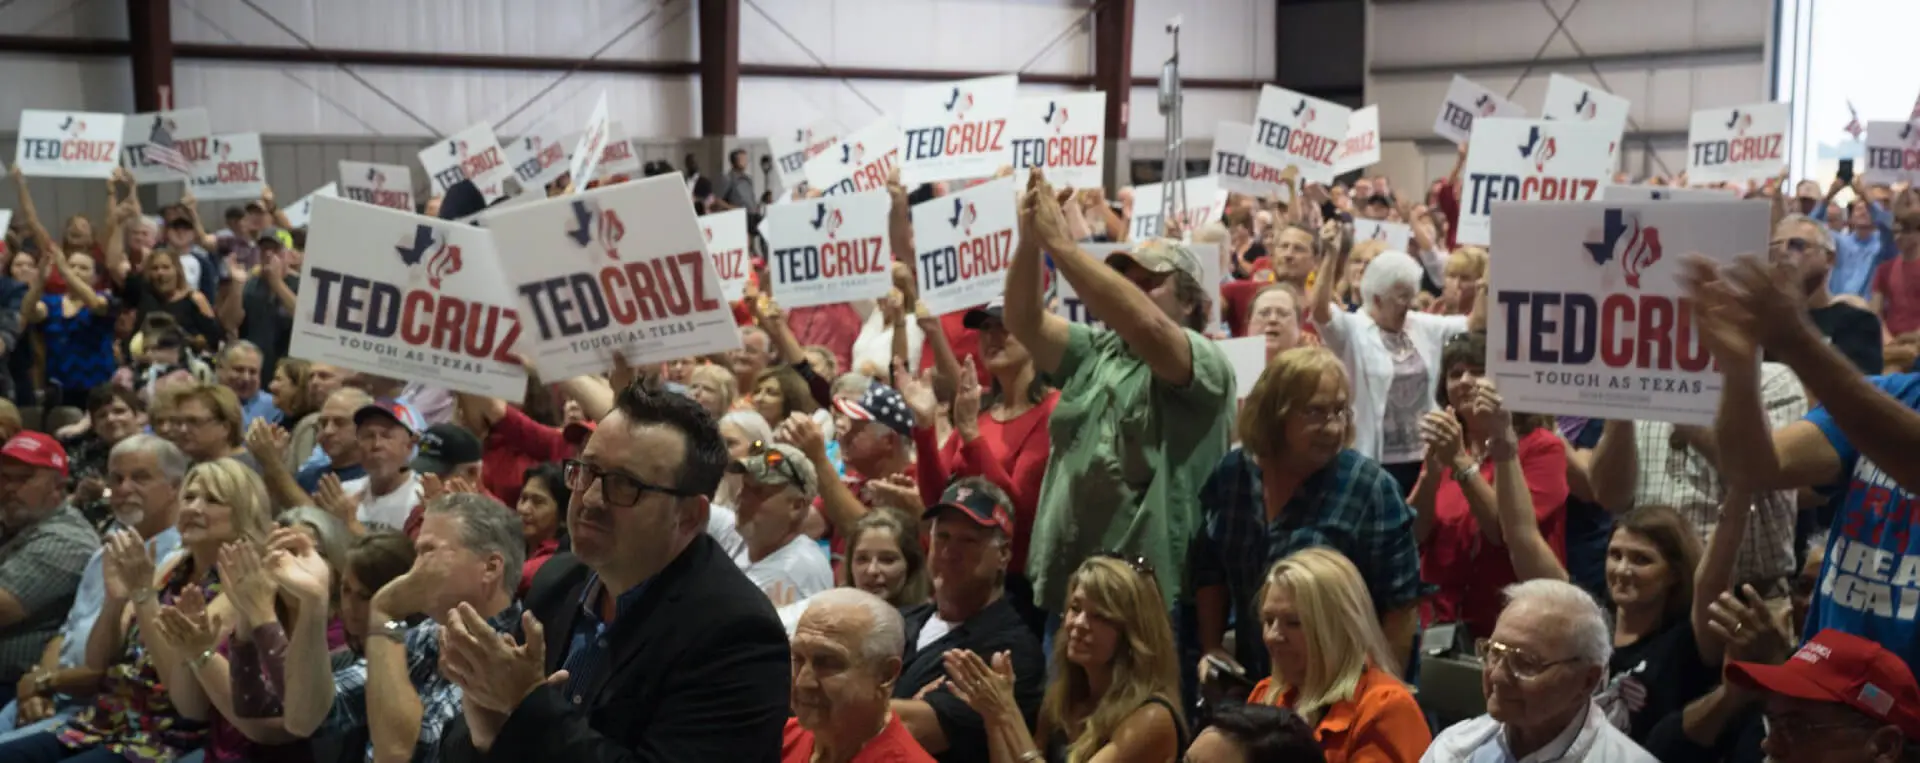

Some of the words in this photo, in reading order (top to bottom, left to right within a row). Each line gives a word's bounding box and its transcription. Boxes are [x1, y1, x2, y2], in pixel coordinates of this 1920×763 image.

[570, 331, 623, 354] TOUGH
[629, 328, 646, 342] AS
[650, 321, 696, 339] TEXAS
[339, 335, 399, 358] TOUGH
[404, 350, 425, 363] AS
[431, 354, 484, 375] TEXAS
[1533, 370, 1601, 388] TOUGH
[1608, 375, 1632, 390] AS
[1639, 377, 1703, 395] TEXAS
